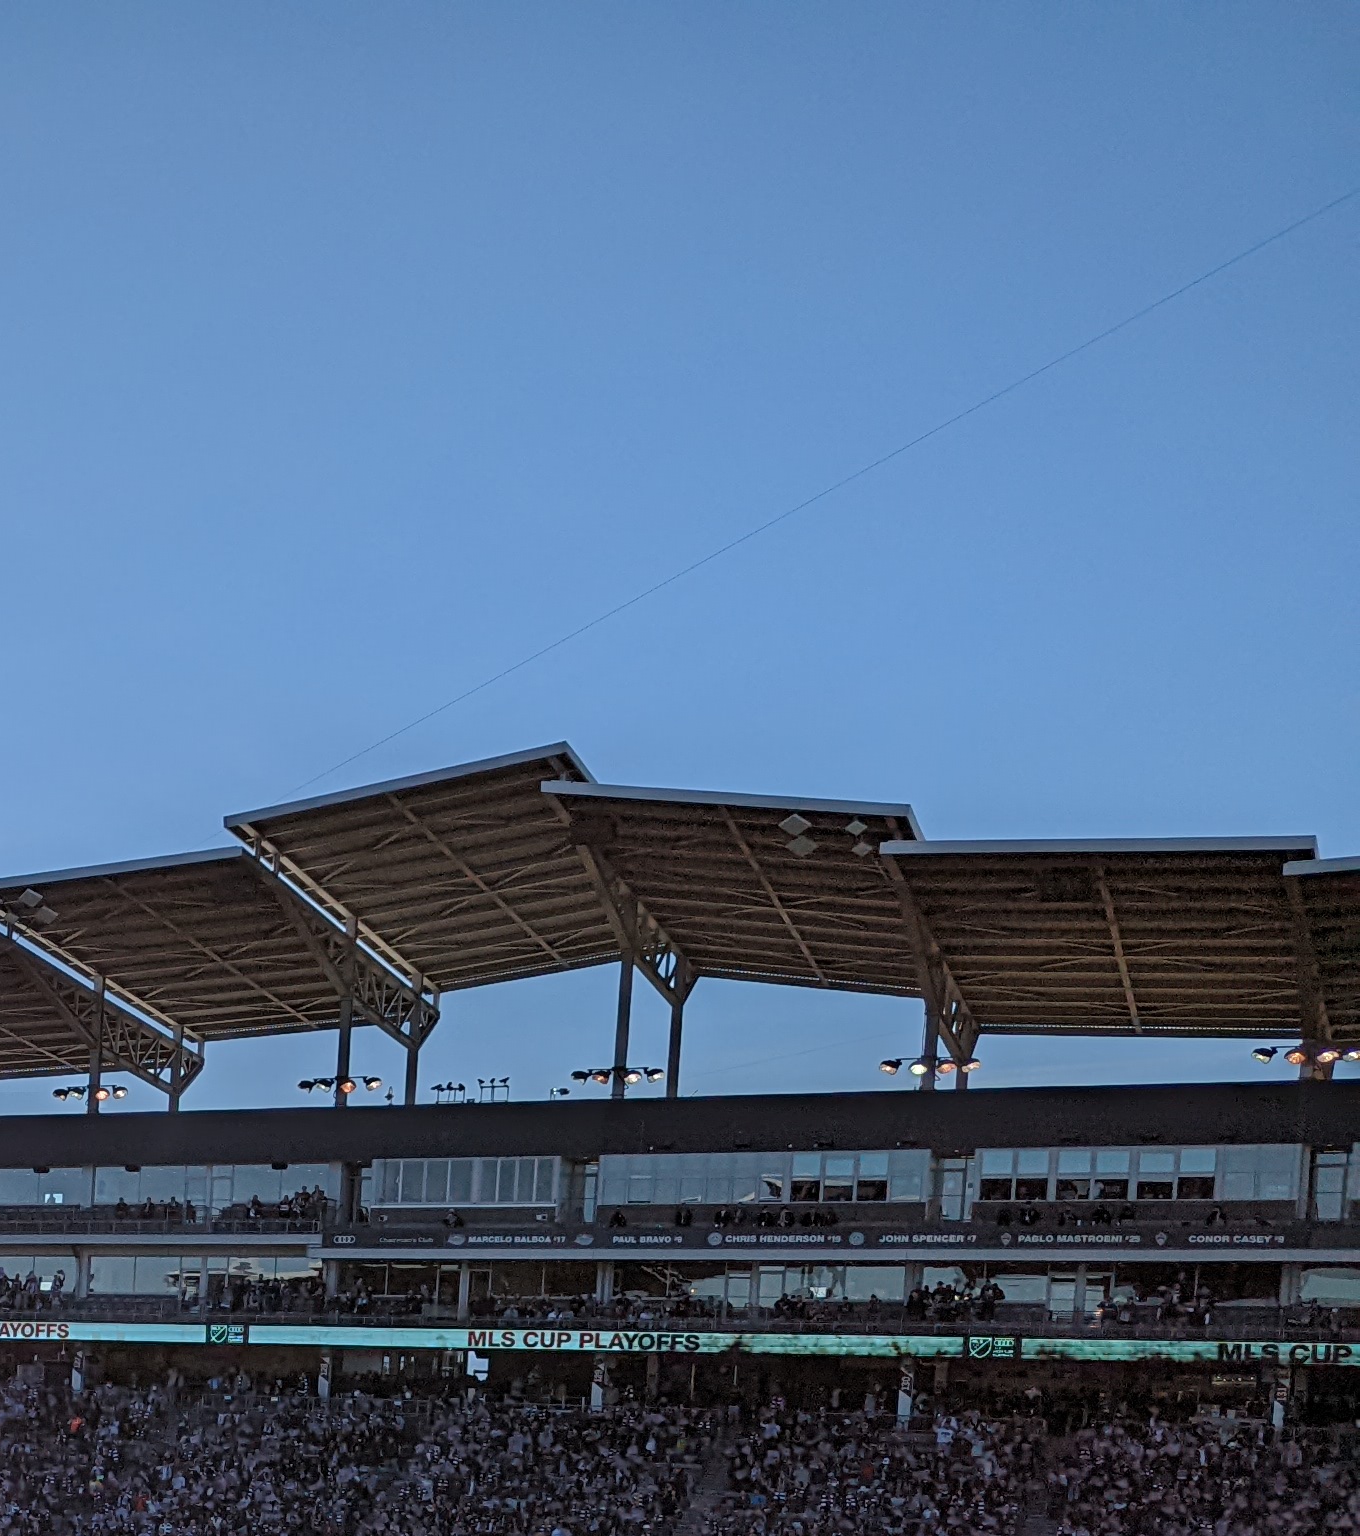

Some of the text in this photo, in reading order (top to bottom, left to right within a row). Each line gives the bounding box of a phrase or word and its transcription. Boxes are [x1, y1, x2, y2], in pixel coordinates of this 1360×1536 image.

[879, 1235, 910, 1243] JOHN
[1233, 1235, 1272, 1243] CASEY
[467, 1331, 701, 1352] MLS CUP PLAYOFFS
[1218, 1343, 1350, 1365] MLS CUP
